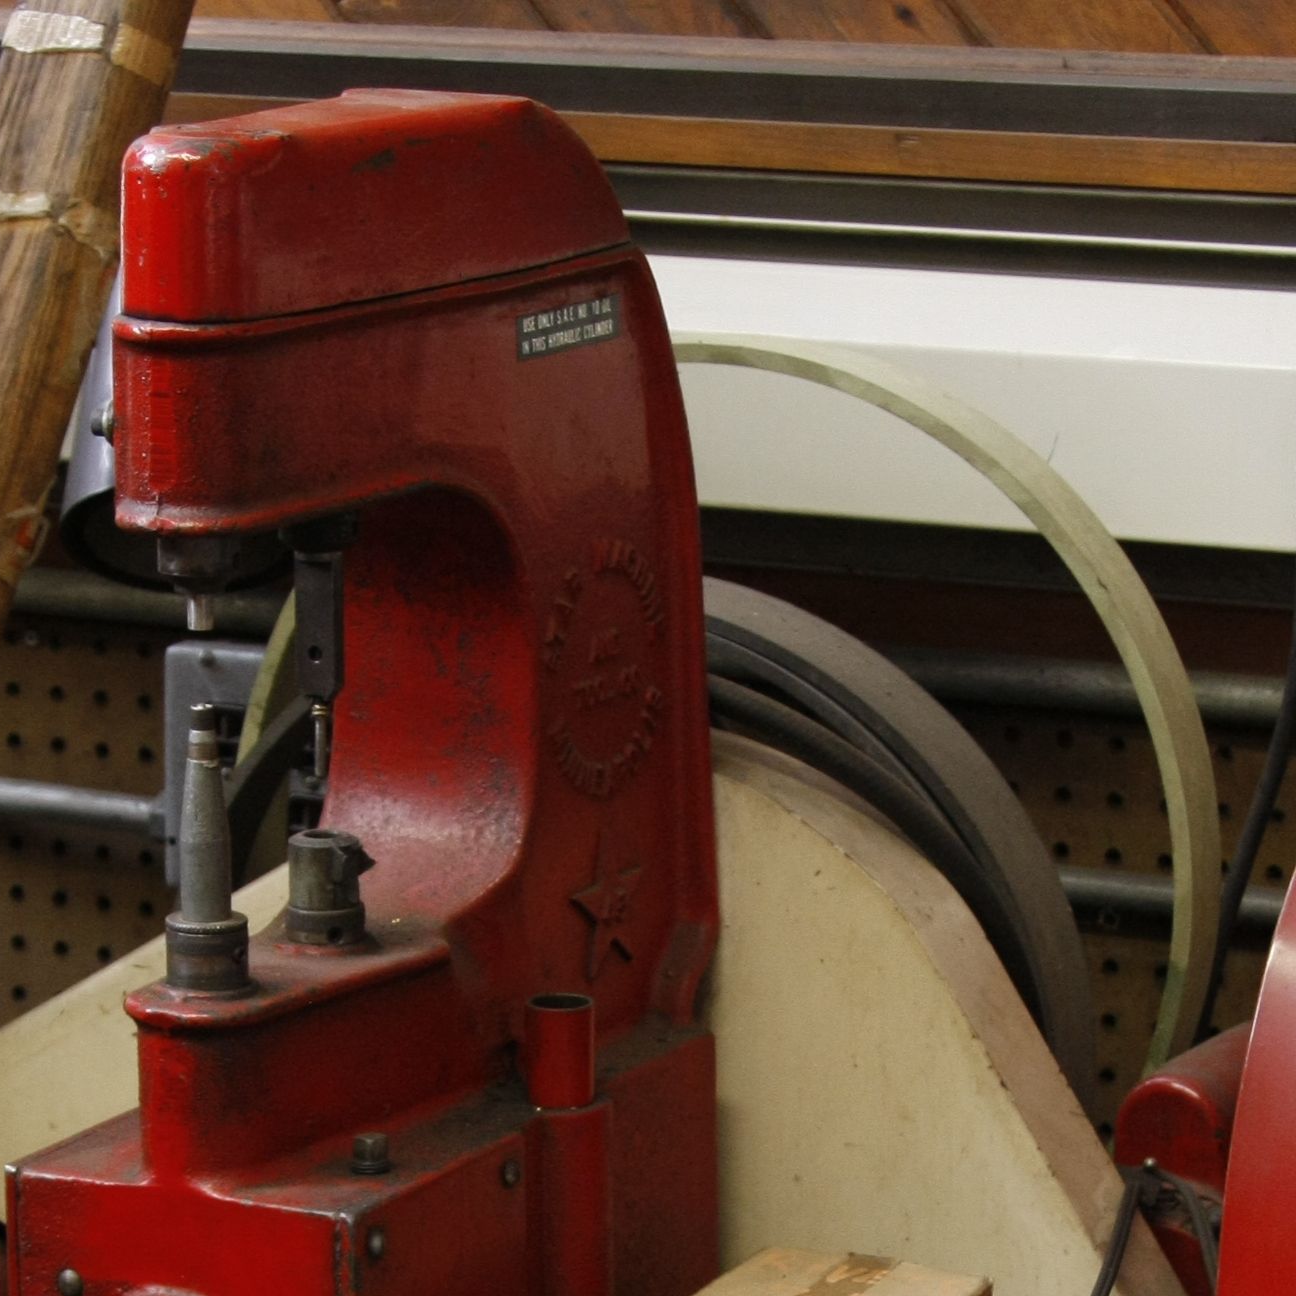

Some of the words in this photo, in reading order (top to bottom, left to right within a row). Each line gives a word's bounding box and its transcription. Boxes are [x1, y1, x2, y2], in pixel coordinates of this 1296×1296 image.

[522, 317, 535, 333] USE
[532, 335, 547, 353] THIS
[548, 327, 582, 349] HYDRAULIC
[583, 318, 614, 339] CYLINDER
